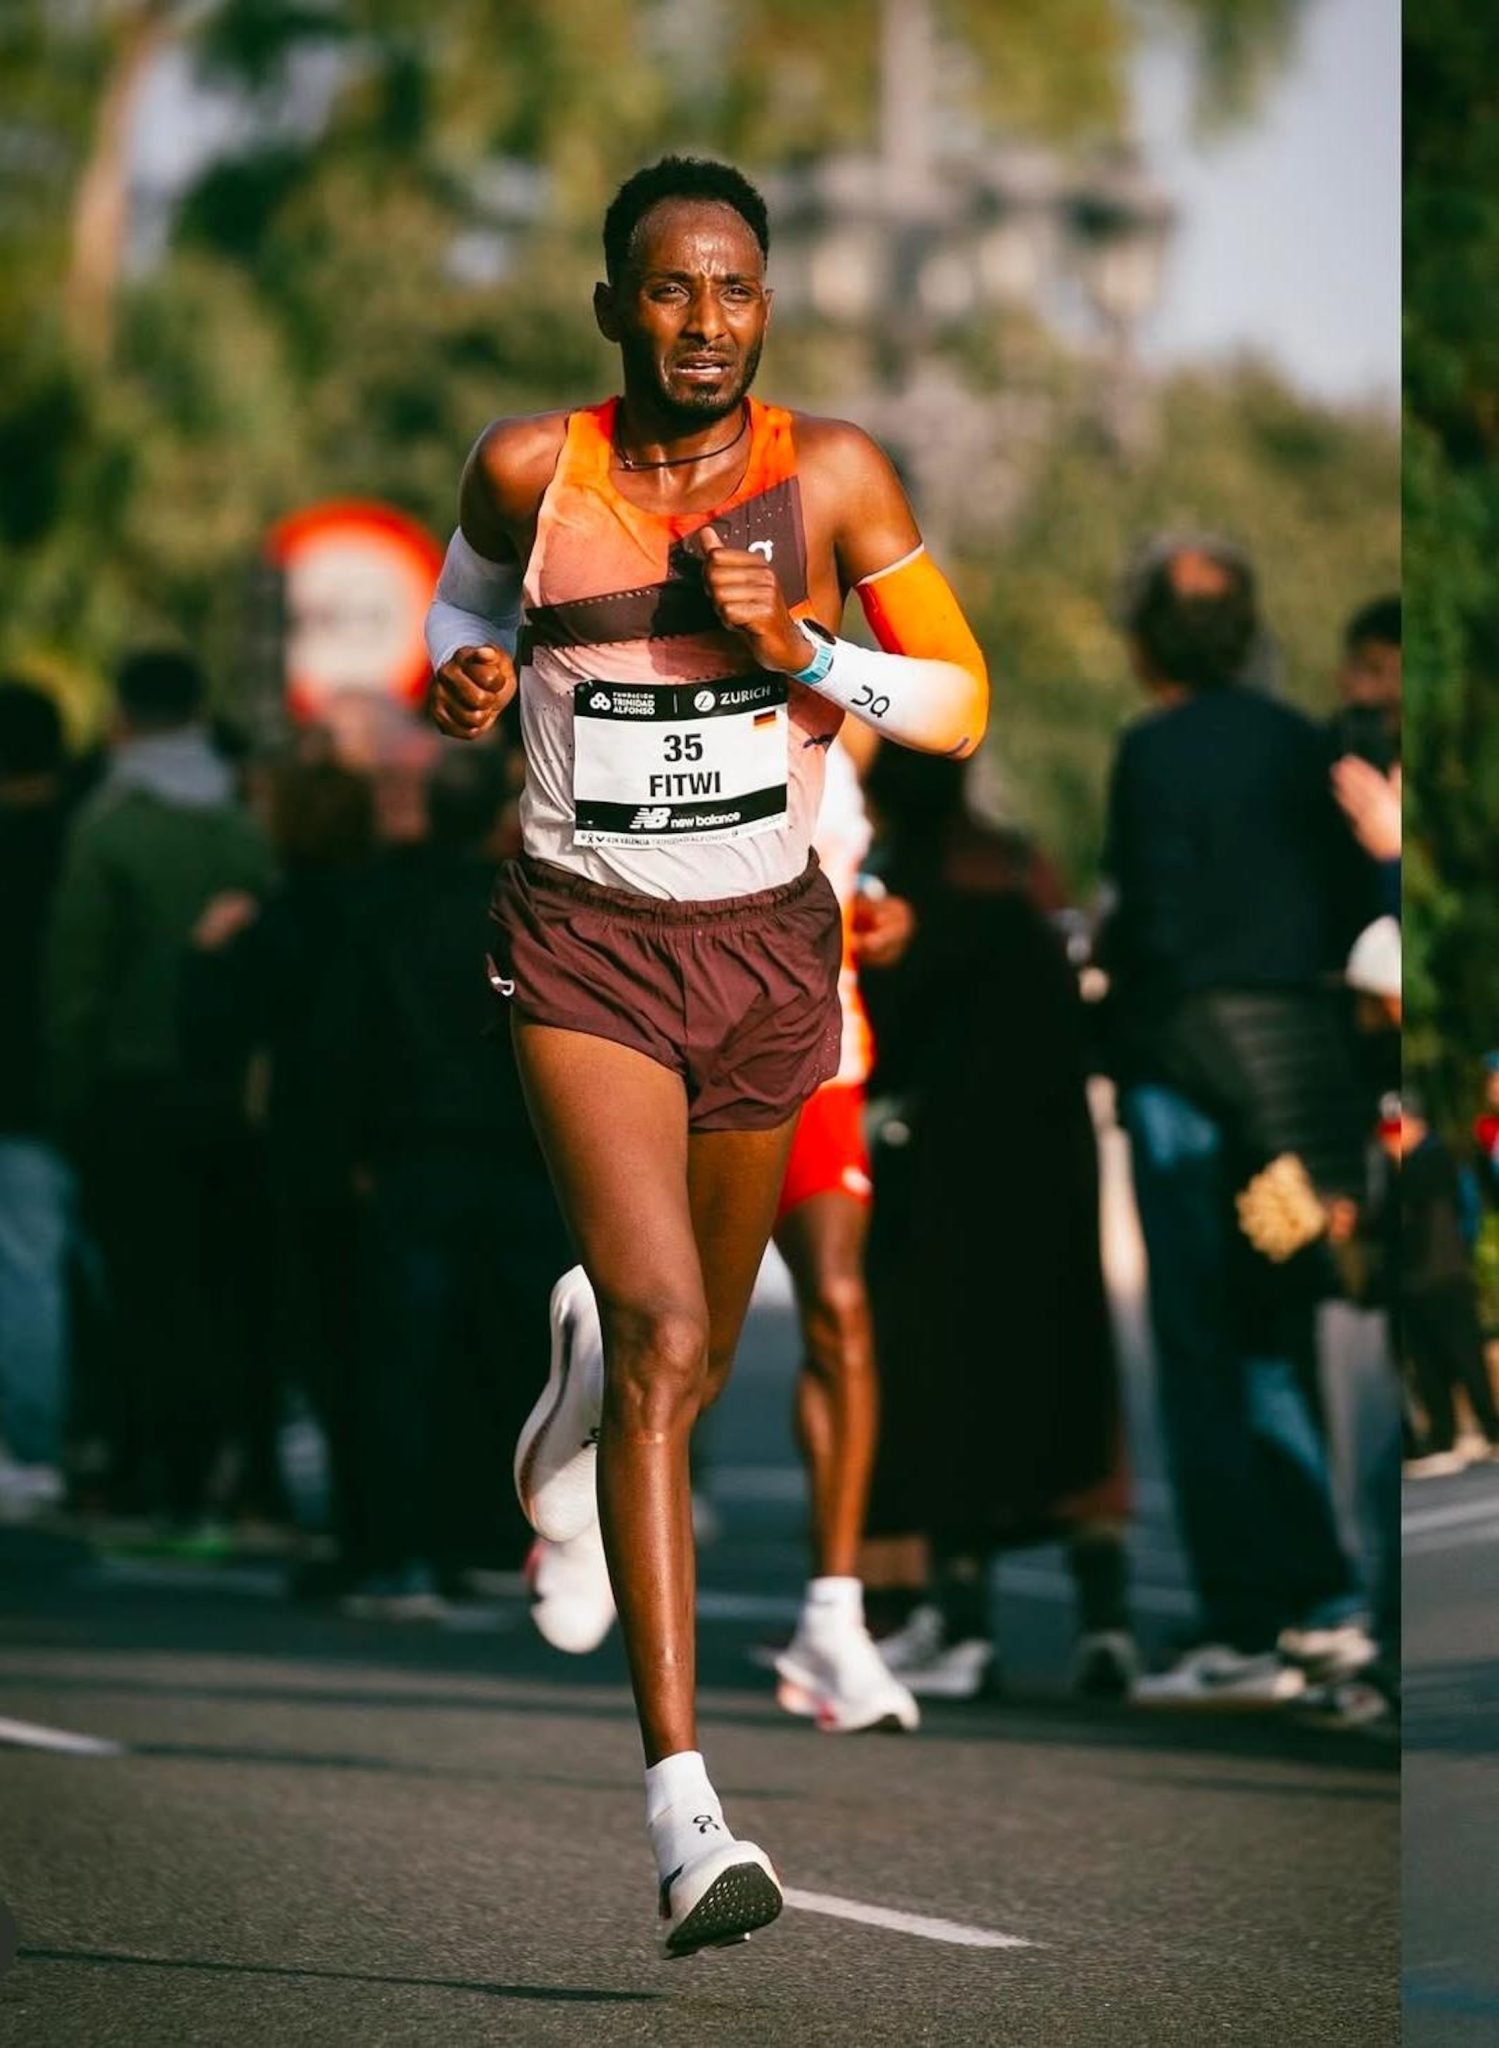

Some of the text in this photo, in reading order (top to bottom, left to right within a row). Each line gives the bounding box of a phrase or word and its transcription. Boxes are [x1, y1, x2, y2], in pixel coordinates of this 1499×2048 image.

[612, 698, 655, 707] TRINIDAD
[720, 685, 771, 705] ZURICH
[612, 706, 655, 715] ALFONSO
[663, 733, 703, 762] 35
[649, 771, 721, 797] FITWI
[671, 817, 694, 828] new
[695, 812, 741, 827] balance
